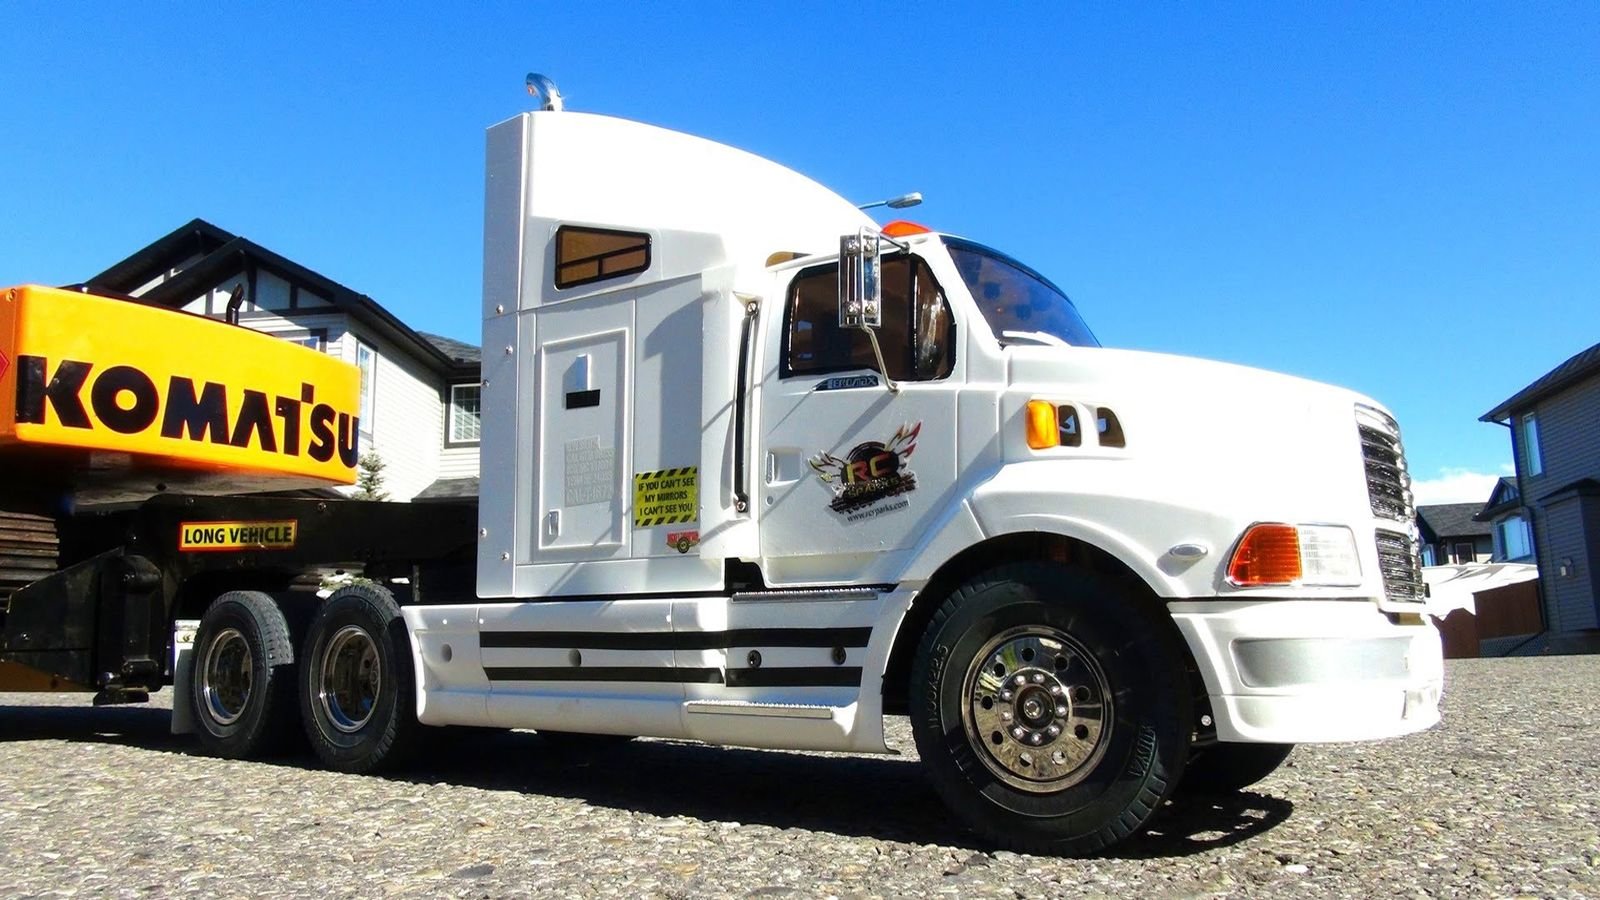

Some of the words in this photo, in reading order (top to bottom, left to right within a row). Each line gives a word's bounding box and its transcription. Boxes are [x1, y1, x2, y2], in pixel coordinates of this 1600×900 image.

[15, 354, 360, 468] KOMATSU
[846, 451, 893, 484] RC
[638, 482, 645, 492] IF
[646, 480, 659, 491] YOU
[661, 478, 681, 490] CAN'T
[682, 476, 695, 487] SEE
[644, 493, 656, 503] MY
[657, 490, 688, 501] MIRRORS
[639, 507, 643, 516] I
[643, 505, 664, 516] CAN'T
[665, 504, 678, 513] SEE
[678, 502, 693, 512] YOU
[184, 527, 226, 545] LONG
[229, 526, 293, 545] VEHICLE
